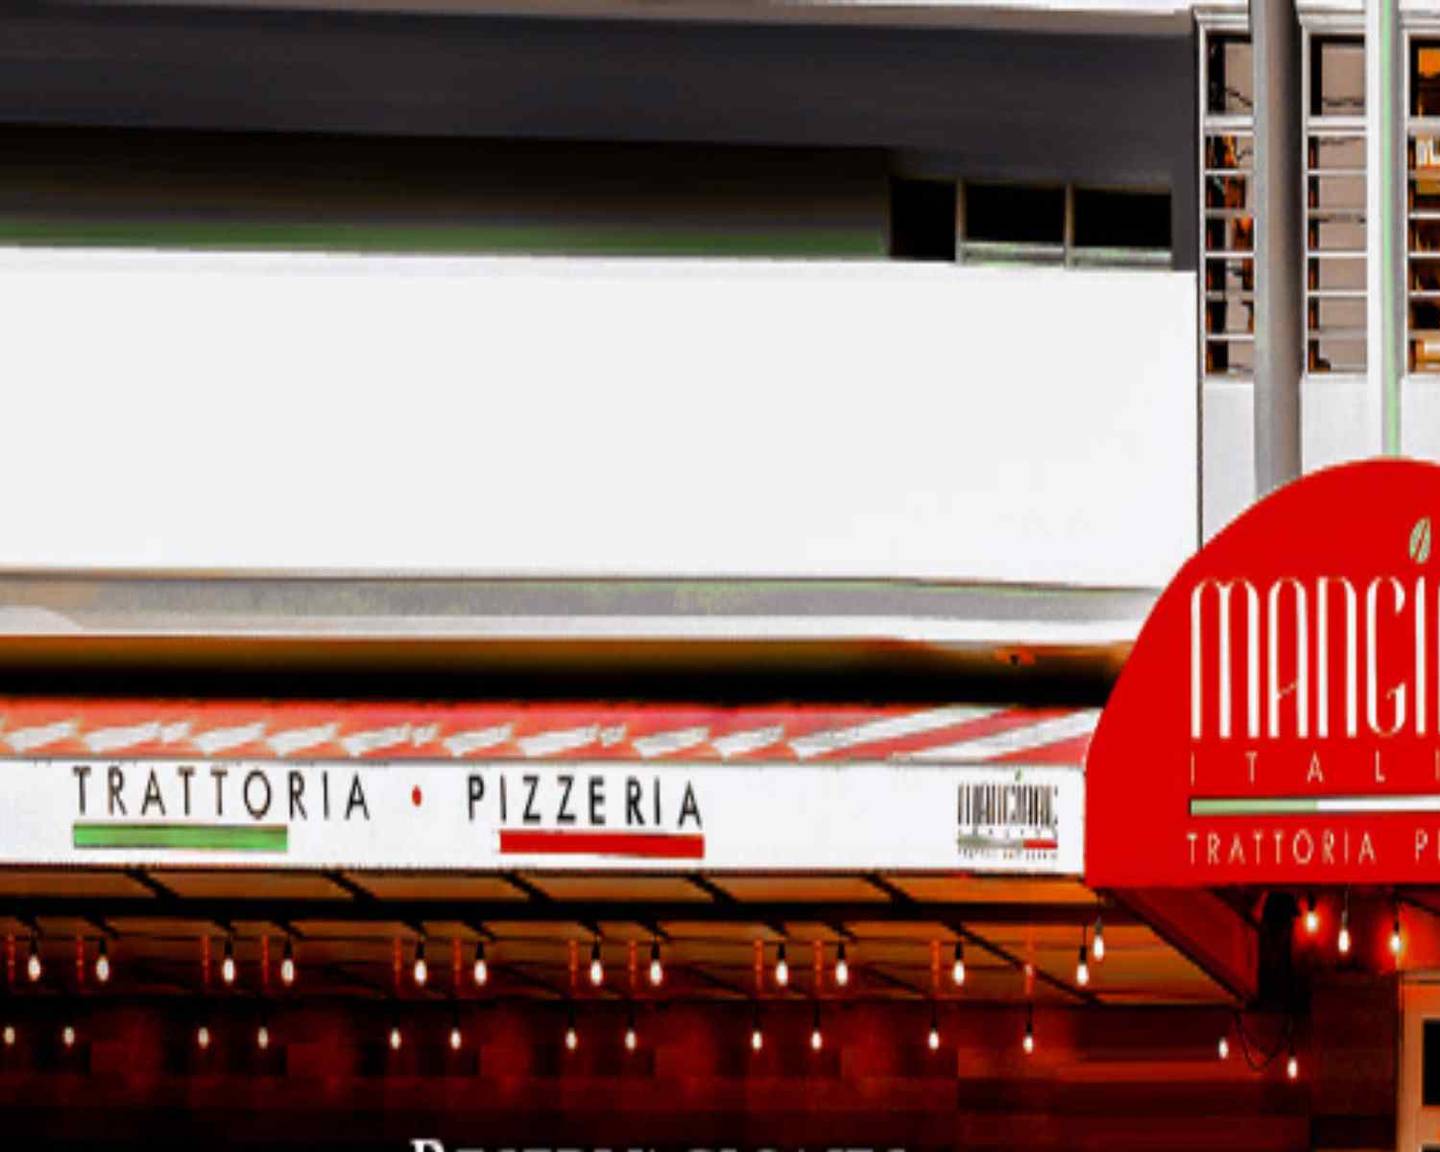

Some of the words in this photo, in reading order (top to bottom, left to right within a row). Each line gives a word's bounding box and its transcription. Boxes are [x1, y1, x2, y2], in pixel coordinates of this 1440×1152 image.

[73, 765, 370, 820] TRATTORIA
[468, 775, 703, 828] PIZZERIA
[1186, 829, 1376, 865] TRATTORIA
